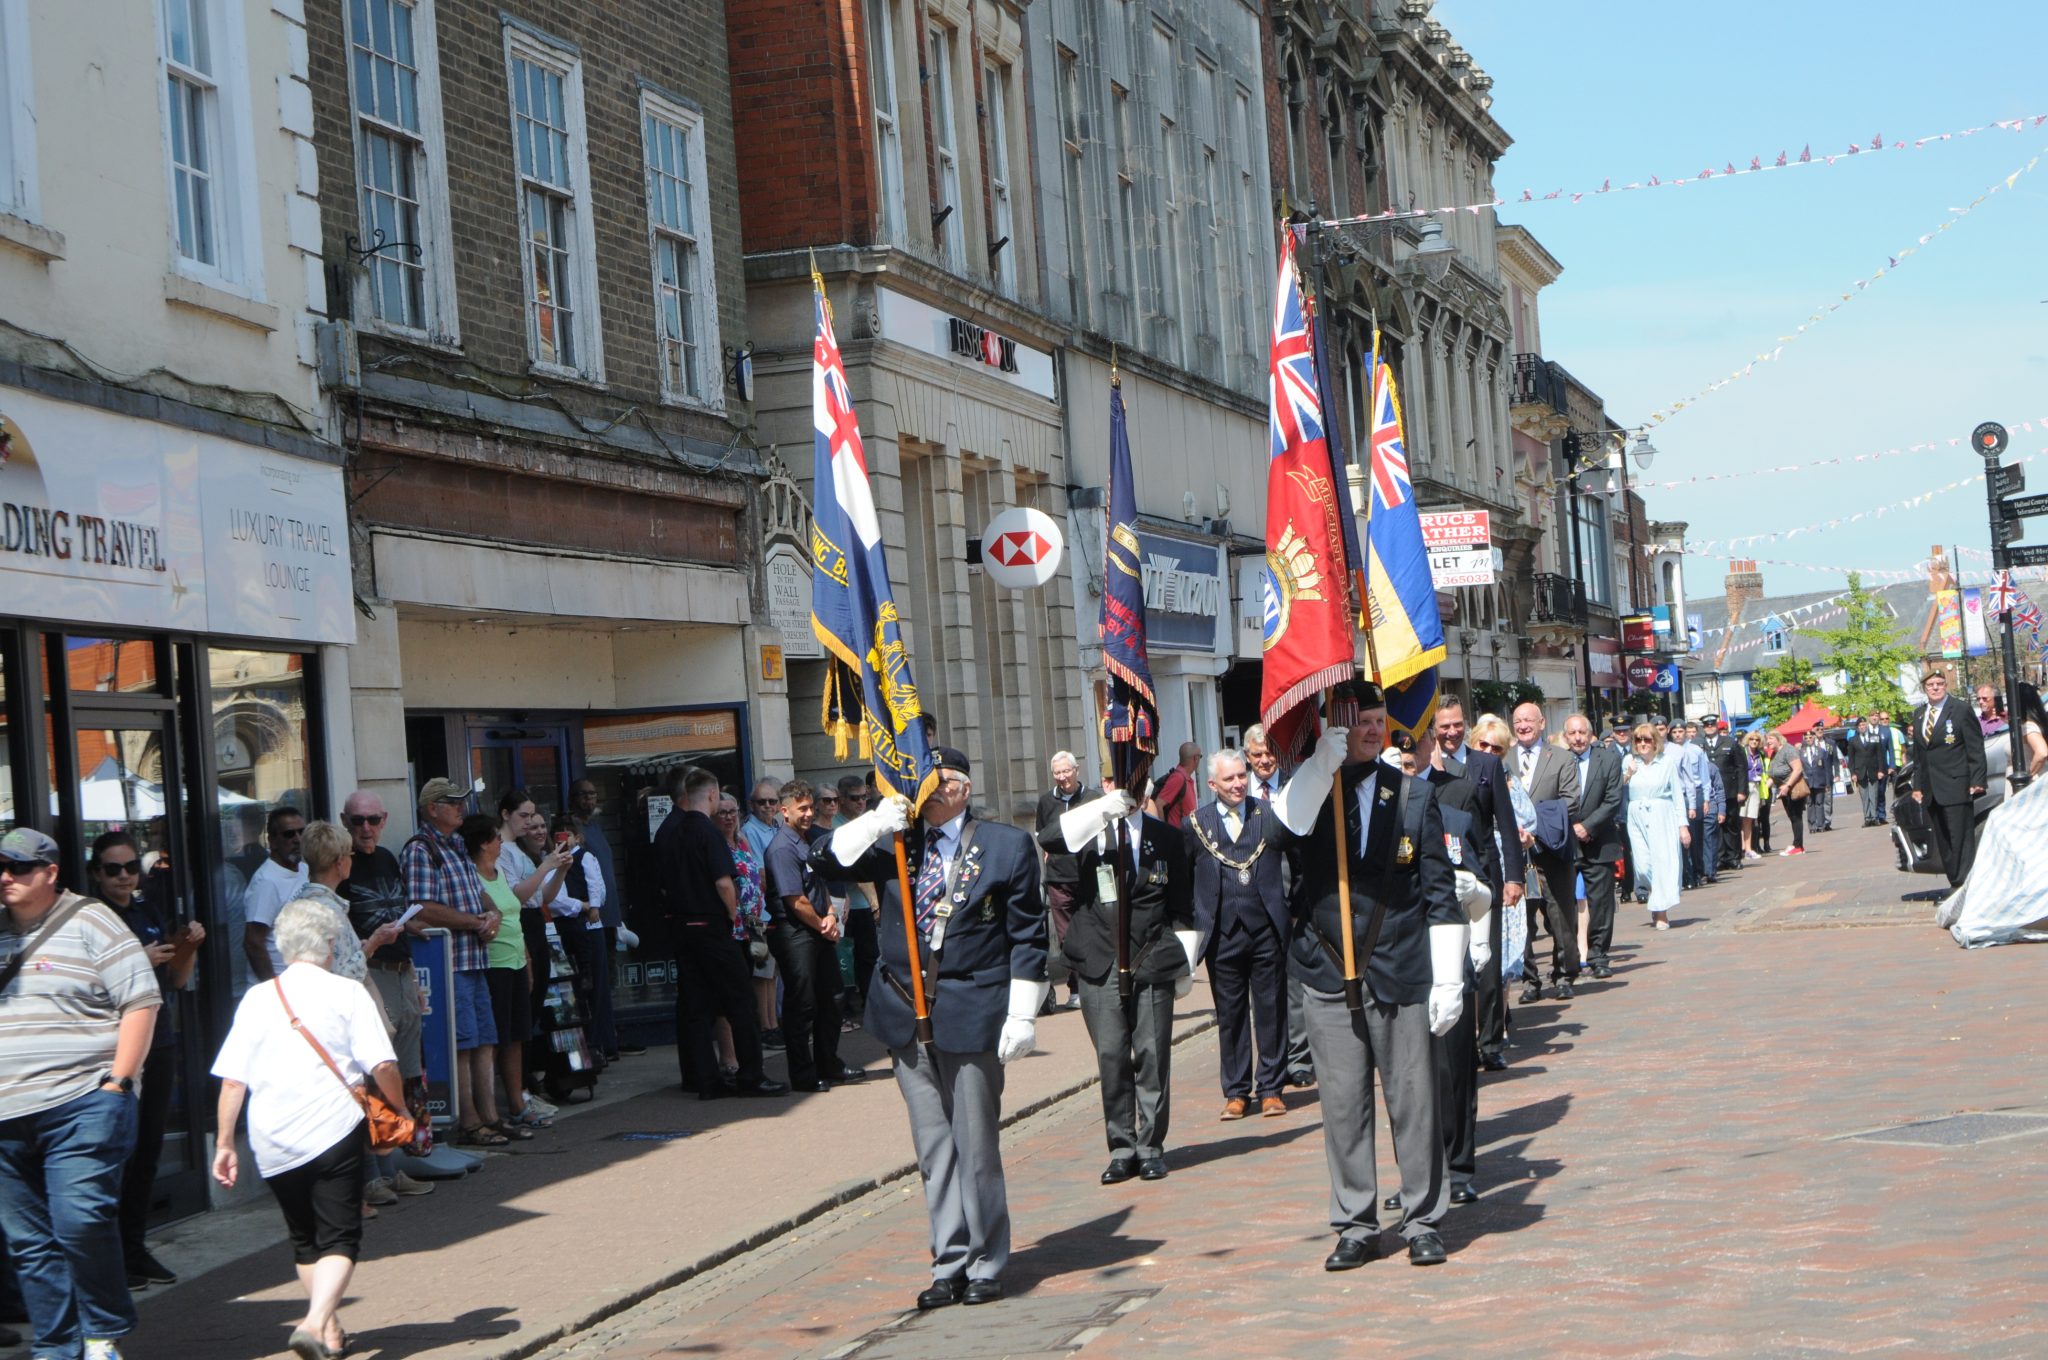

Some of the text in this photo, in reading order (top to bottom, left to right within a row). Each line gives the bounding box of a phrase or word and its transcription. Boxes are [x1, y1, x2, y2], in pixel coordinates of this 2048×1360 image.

[949, 318, 1020, 374] HSBC UK
[1318, 478, 1342, 566] MERCHANT
[1420, 514, 1476, 528] RUCE
[0, 502, 167, 573] DING TRAVEL
[230, 507, 336, 556] LUXURY TRAVEL
[1421, 525, 1487, 540] ATHER
[1425, 536, 1488, 547] MERCIAL
[773, 563, 797, 576] HOLE
[1433, 556, 1460, 569] LET
[264, 561, 310, 592] LOUNGE
[774, 585, 799, 598] WALL
[775, 597, 800, 607] PASSAGE
[694, 720, 726, 736] travel
